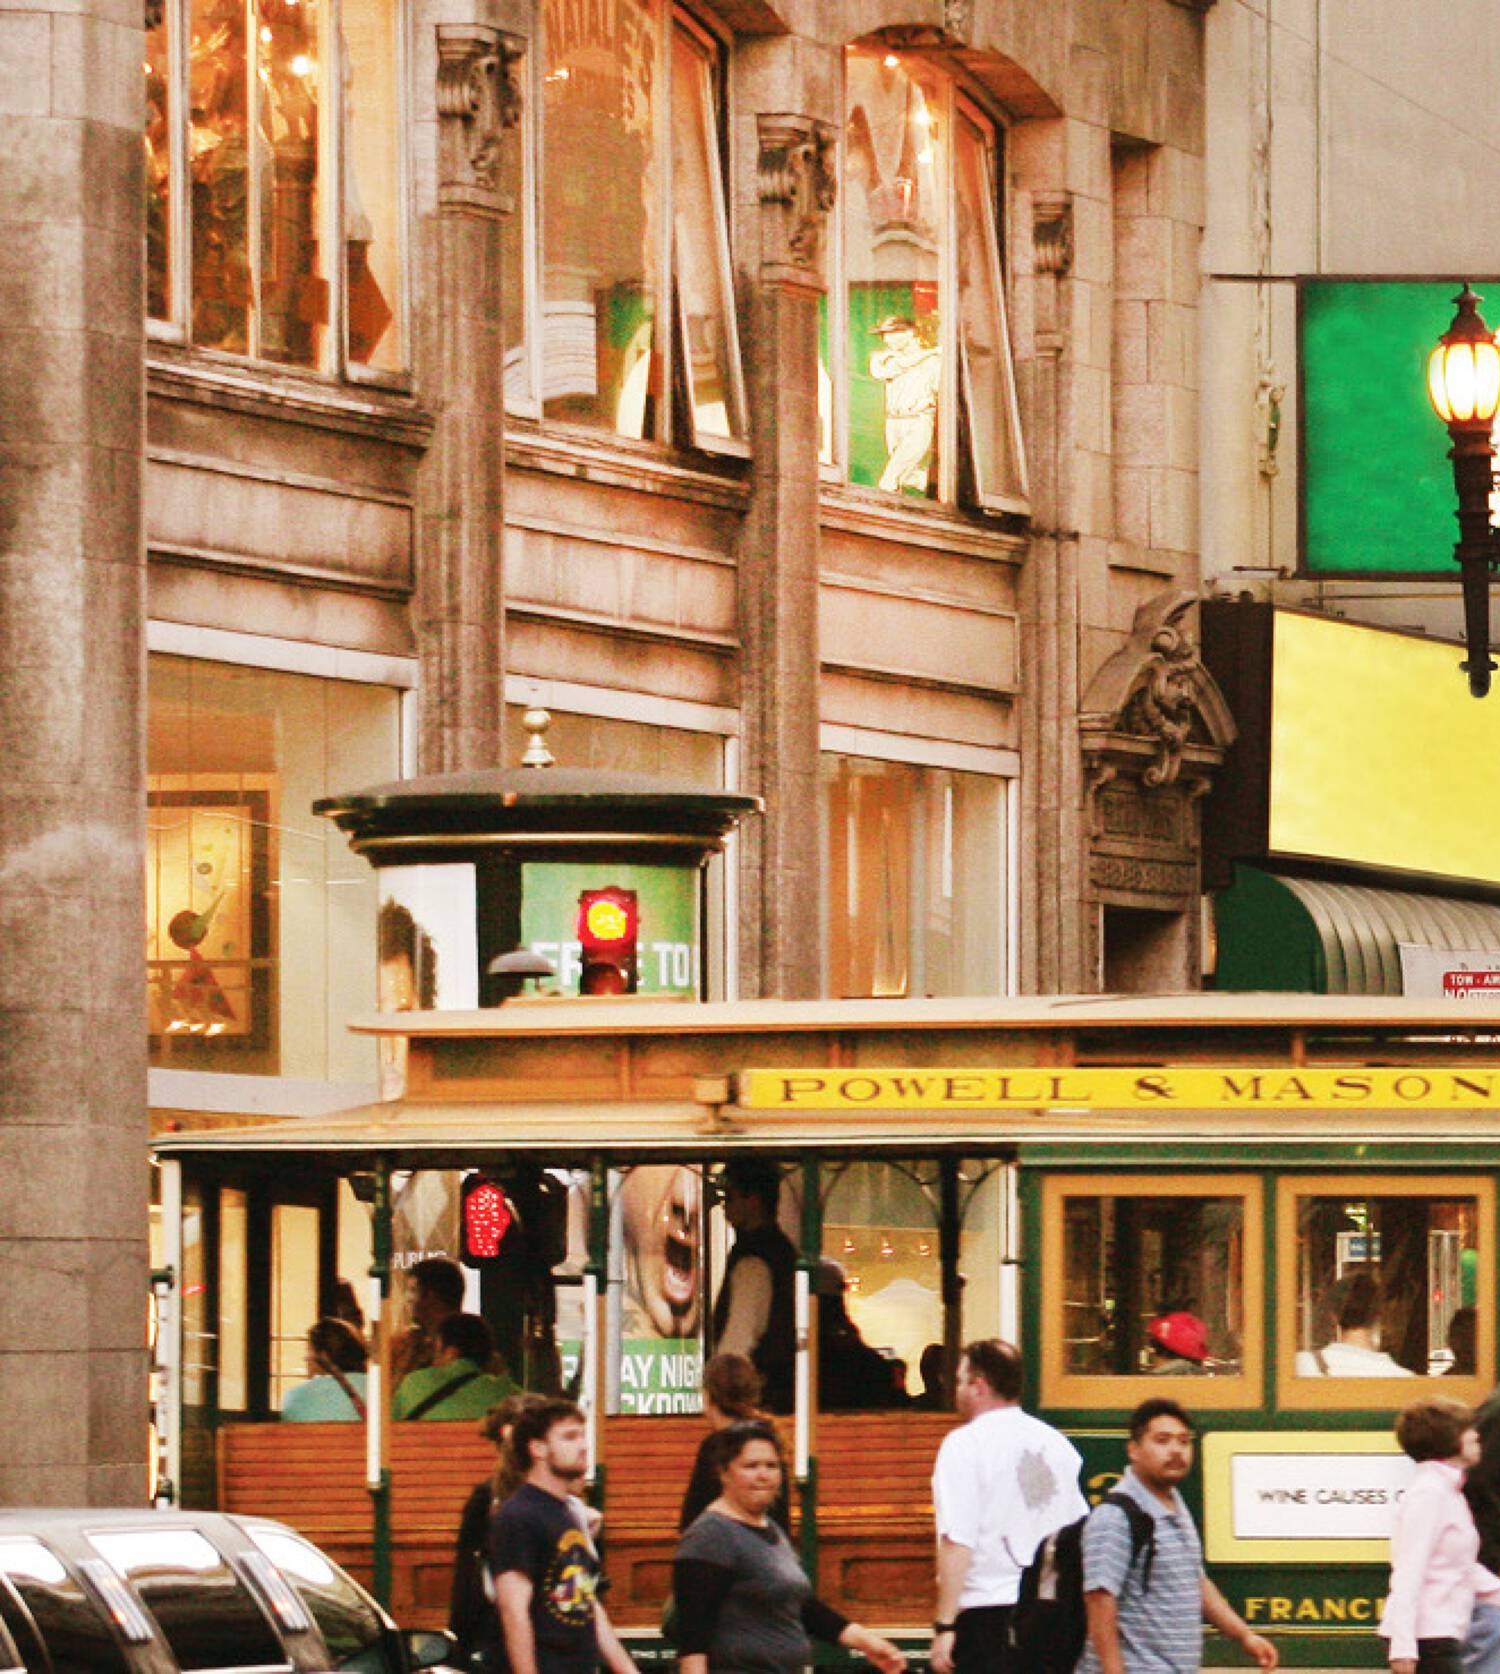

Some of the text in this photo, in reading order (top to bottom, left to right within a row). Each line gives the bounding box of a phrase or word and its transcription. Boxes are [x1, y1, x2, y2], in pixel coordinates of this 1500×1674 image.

[781, 1077, 1092, 1102] POWELL
[1134, 1075, 1178, 1101] &
[1221, 1075, 1498, 1101] MASON
[1258, 1487, 1308, 1504] WINE
[1315, 1487, 1387, 1504] CAUSES
[1244, 1597, 1388, 1621] FRANCI
